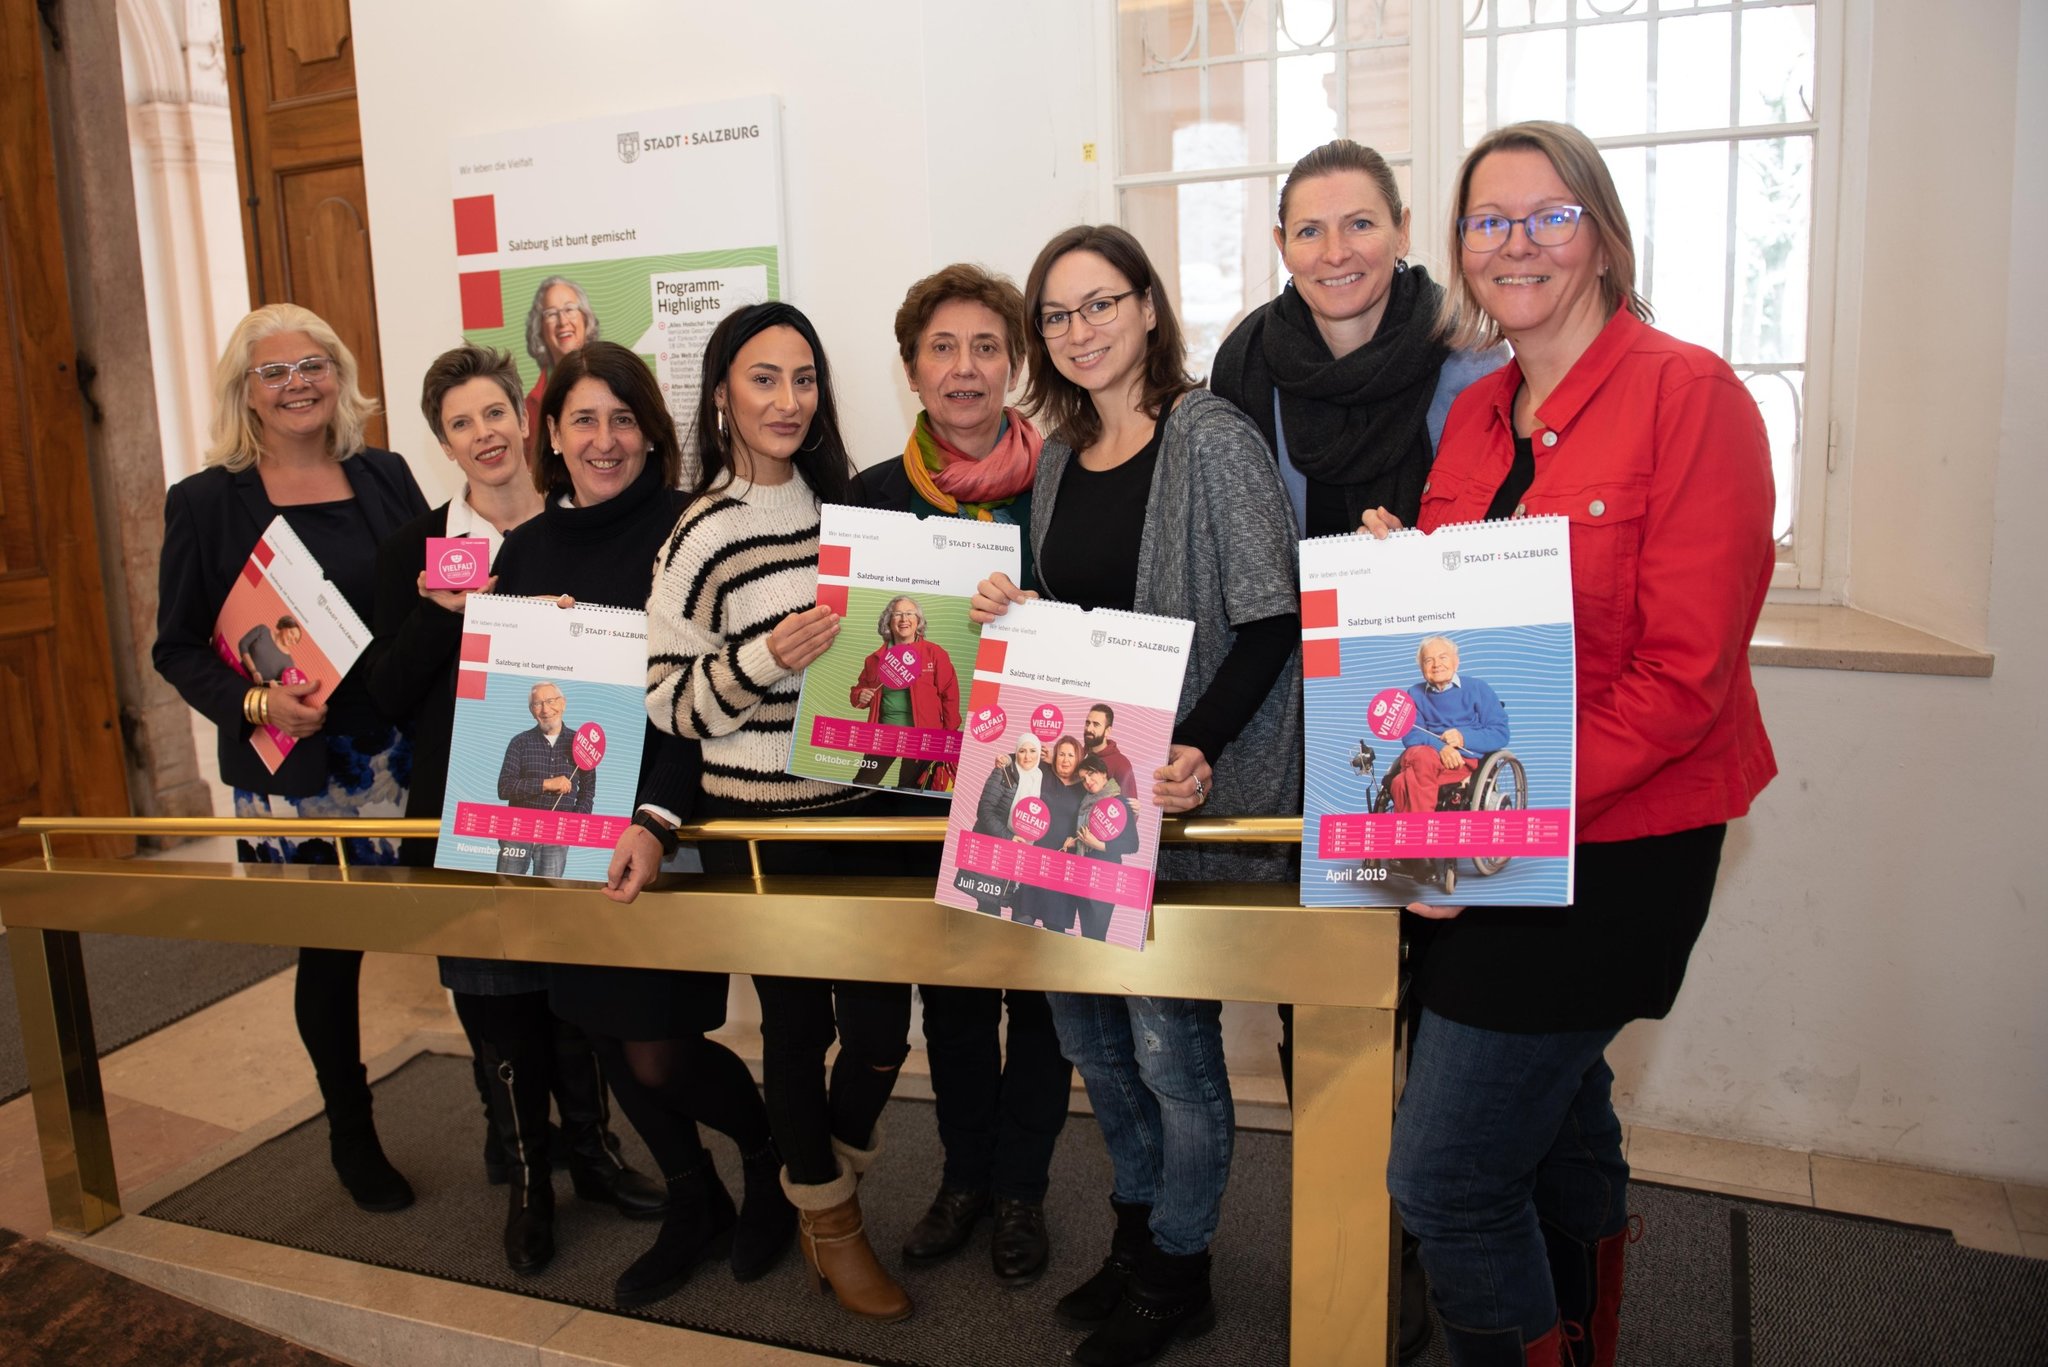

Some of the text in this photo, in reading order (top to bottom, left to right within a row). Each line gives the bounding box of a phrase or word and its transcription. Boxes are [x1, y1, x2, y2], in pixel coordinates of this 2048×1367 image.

[644, 135, 681, 151] STADT
[692, 125, 760, 145] SALZBURG
[508, 229, 636, 252] Salzburg ist bunt gemischt
[657, 280, 725, 297] Programm-
[658, 297, 721, 315] Highlights
[948, 539, 971, 548] STADT
[977, 543, 1015, 553] SALZBURG
[1464, 552, 1495, 563] STADT
[1503, 548, 1558, 560] SALZBURG
[442, 562, 473, 573] VIELFALT
[856, 572, 940, 586] Salzburg ist bunt gemischt
[1347, 611, 1456, 627] Salzburg ist bunt gemischt
[585, 627, 607, 636] STADT
[612, 630, 648, 640] SALZBURG
[1107, 636, 1131, 647] STADT
[1137, 640, 1180, 654] SALZBURG
[495, 658, 521, 668] Salzburg
[531, 662, 545, 670] bunt
[546, 664, 574, 673] gemischt
[884, 651, 915, 683] VIELFALT
[1009, 668, 1091, 688] Salzburg ist bunt gemischt
[1377, 691, 1406, 736] VIELFALT
[973, 713, 1004, 735] VIELFALT
[1032, 719, 1062, 729] VIELFALT
[577, 731, 602, 762] VIELFALT
[814, 753, 878, 769] Oktober 2019
[1015, 808, 1048, 830] VIELFALT
[1092, 805, 1119, 836] VIELFALT
[457, 842, 527, 858] November 2019
[1326, 868, 1387, 883] April 2019
[957, 876, 1001, 896] Juli 2019
